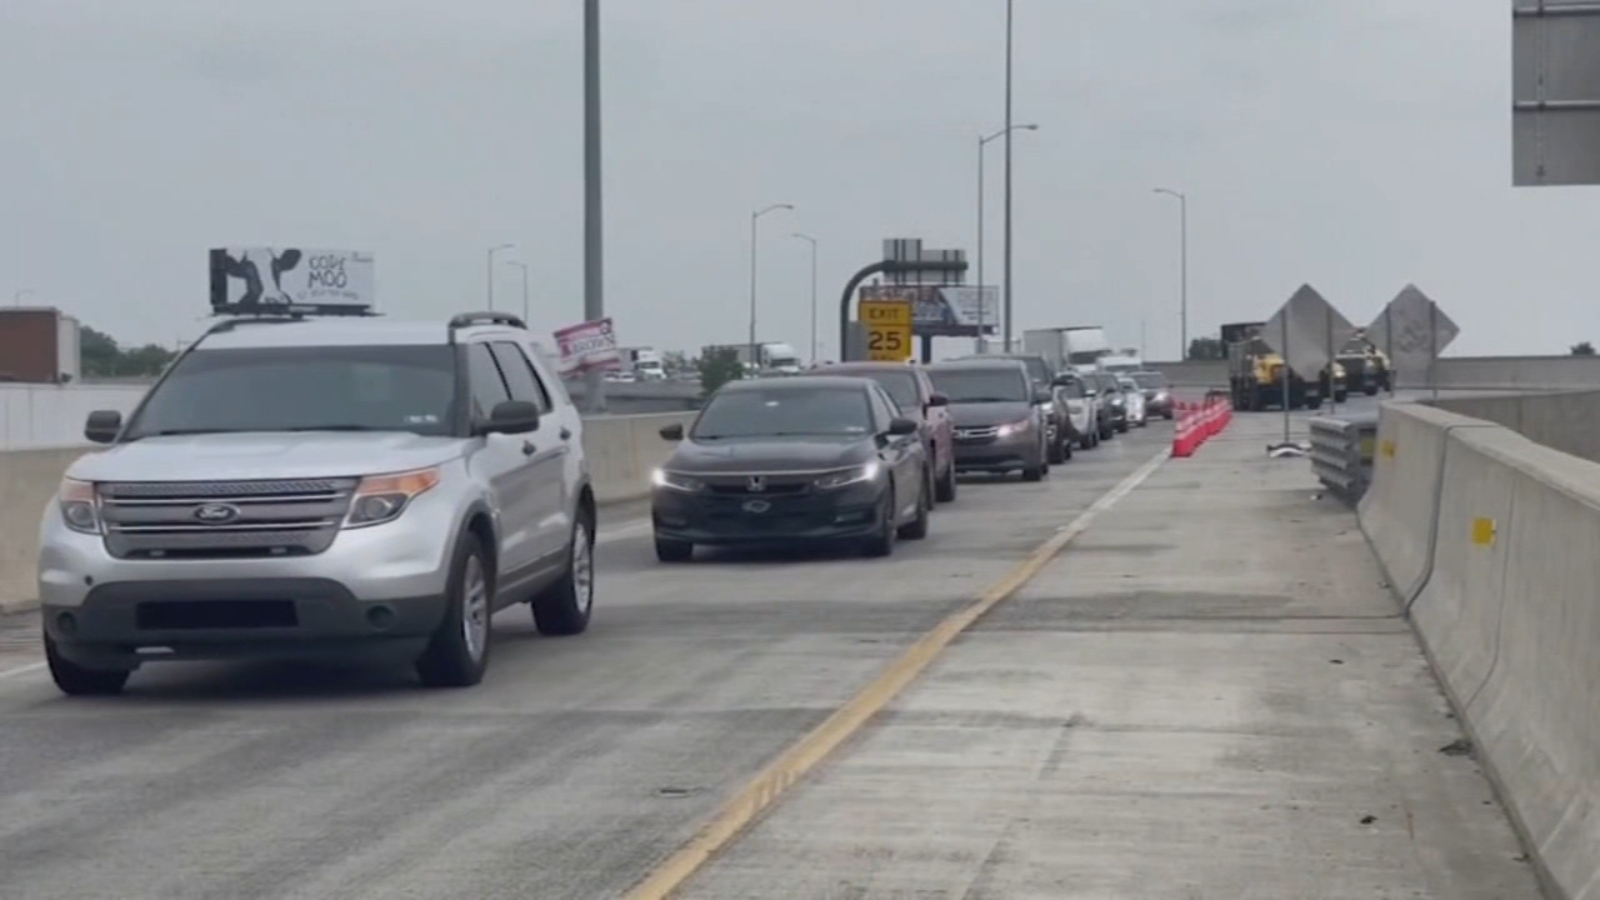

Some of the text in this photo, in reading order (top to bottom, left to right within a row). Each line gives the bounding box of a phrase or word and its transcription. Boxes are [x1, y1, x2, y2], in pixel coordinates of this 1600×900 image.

[308, 270, 347, 288] MOO
[868, 308, 899, 320] EXIT
[868, 331, 901, 351] 25
